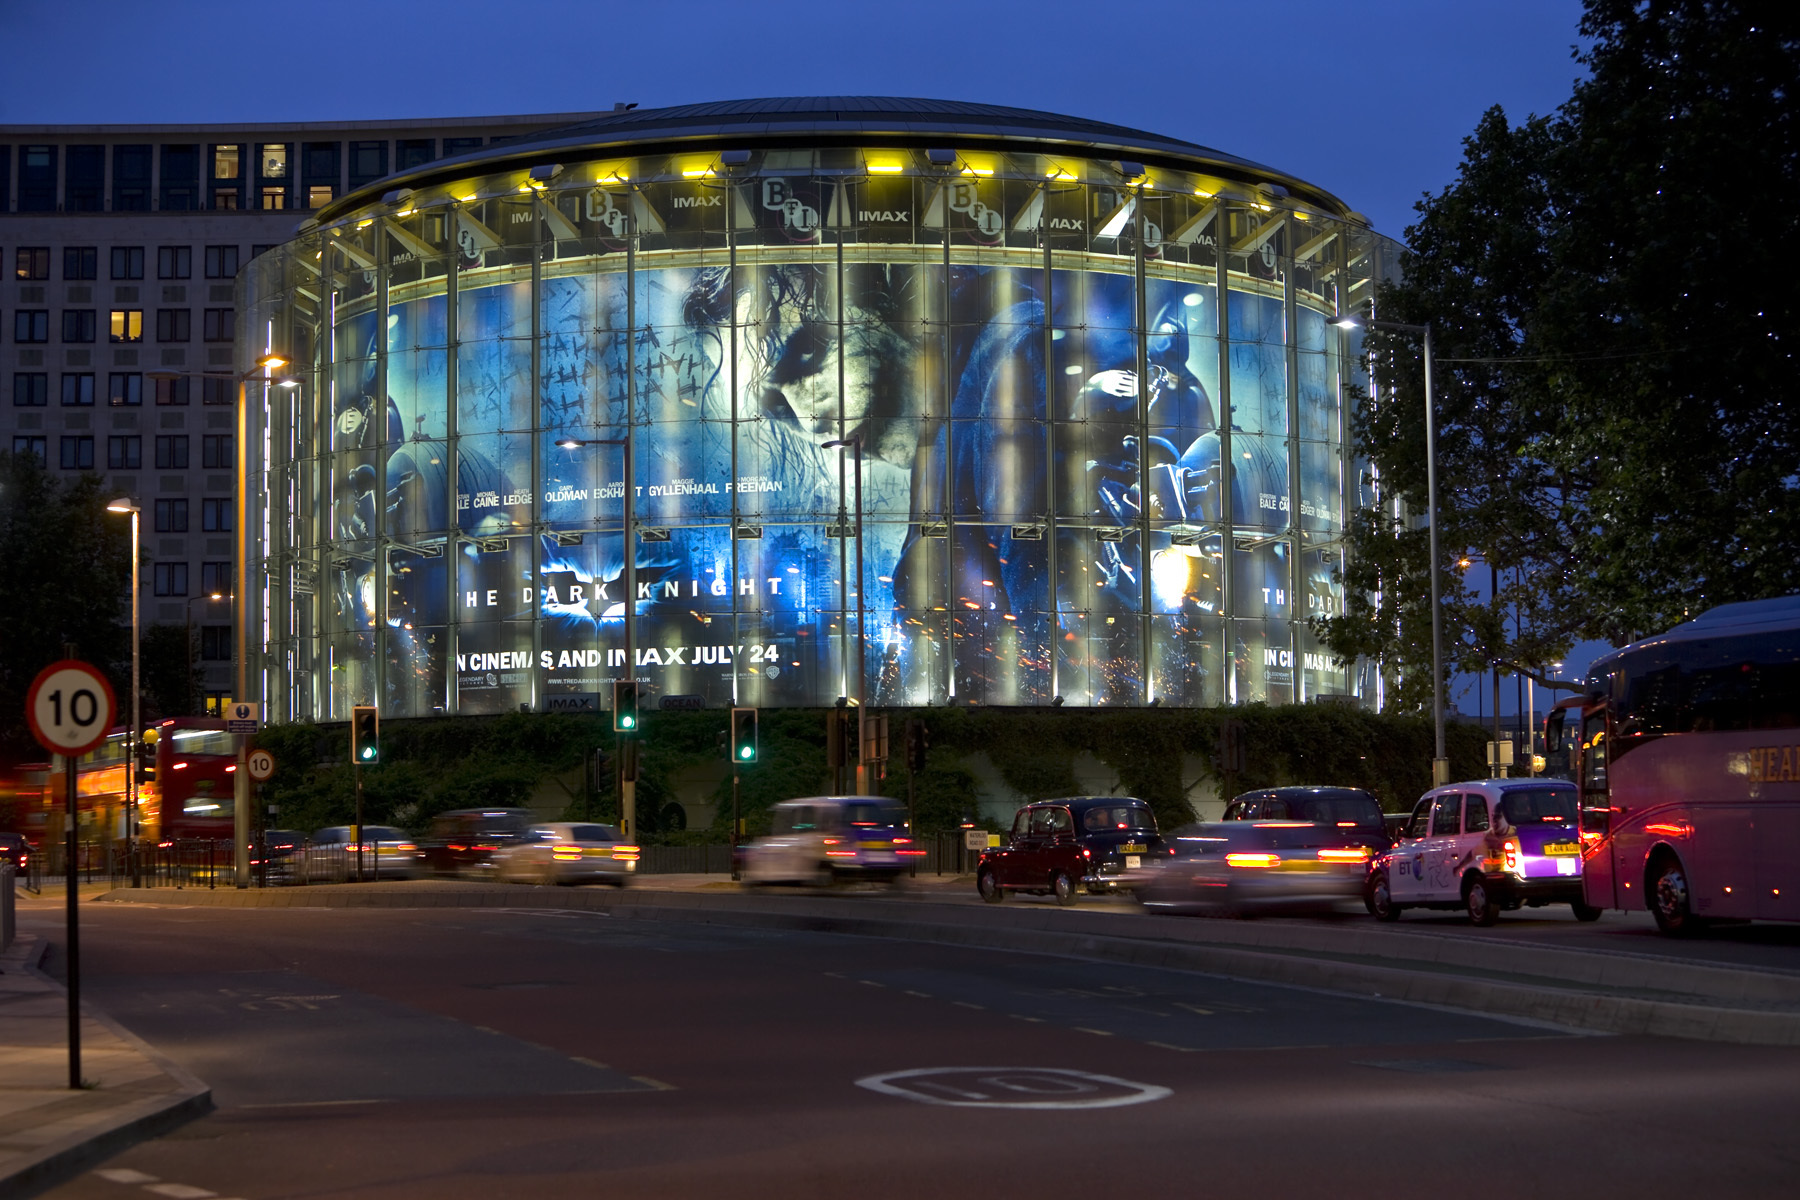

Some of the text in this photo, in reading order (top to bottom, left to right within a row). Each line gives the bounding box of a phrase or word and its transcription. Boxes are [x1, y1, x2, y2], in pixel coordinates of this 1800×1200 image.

[673, 195, 722, 209] IMAX
[767, 181, 809, 229] BFI
[953, 184, 995, 232] BFI
[858, 210, 909, 222] IMAX
[473, 495, 500, 508] CAINE
[503, 493, 533, 506] LEDGE
[545, 489, 588, 502] OLDMAN
[593, 486, 643, 499] ECKHAT
[649, 483, 719, 497] GYLLENHAAL
[725, 481, 783, 493] FREEMAN
[1259, 498, 1277, 510] BALE
[1300, 504, 1315, 516] EDGER
[466, 577, 782, 607] HE DARK KNIGHT
[1262, 588, 1339, 613] TH DARK
[557, 649, 602, 668] AND
[691, 645, 744, 665] JULY
[749, 644, 779, 663] 24
[1264, 649, 1277, 666] IN
[50, 690, 98, 726] 10
[549, 698, 590, 709] IMAX
[664, 698, 701, 708] OCEAN
[253, 758, 269, 771] 10
[1749, 747, 1800, 782] HEA
[1399, 861, 1412, 875] BT
